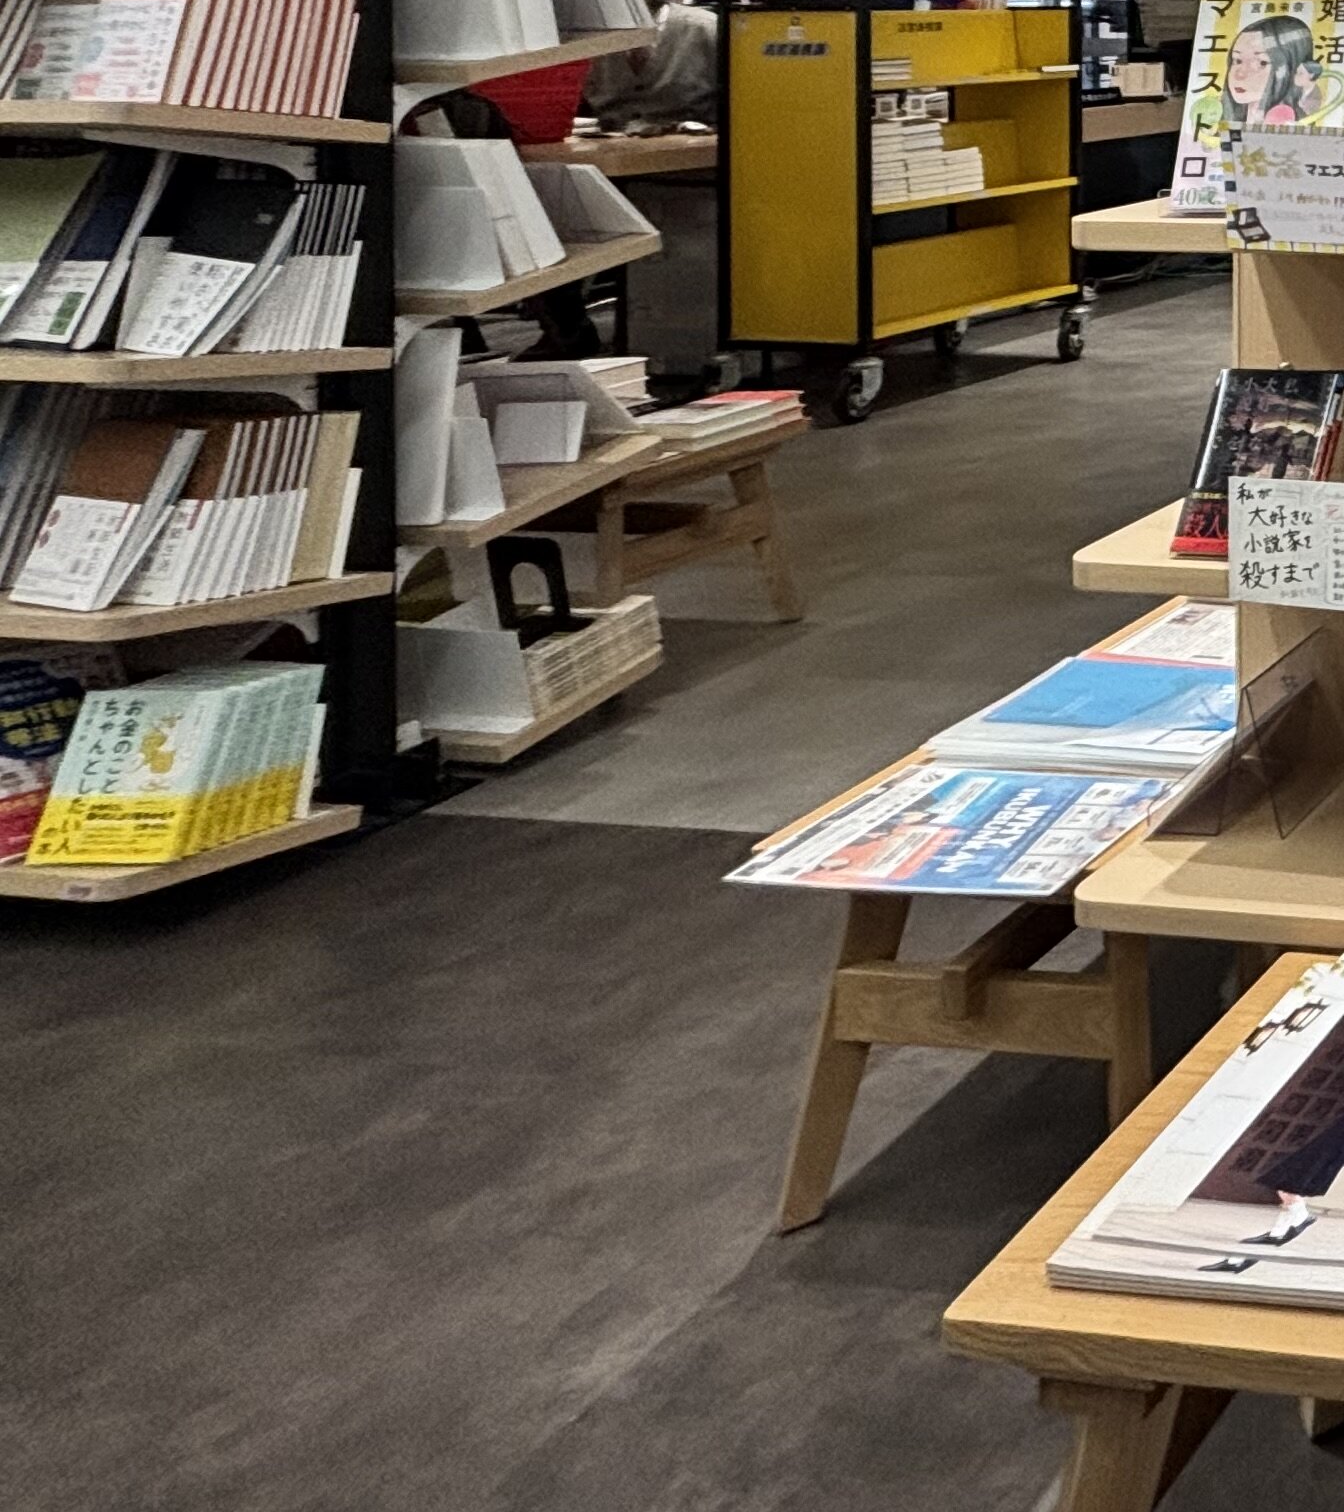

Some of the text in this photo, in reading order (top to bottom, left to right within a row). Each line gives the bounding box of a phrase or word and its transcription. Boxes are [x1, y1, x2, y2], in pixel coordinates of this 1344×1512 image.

[1235, 483, 1274, 504] 私が
[1248, 505, 1314, 527] 大好きな
[1243, 531, 1314, 554] 小説家を
[1239, 559, 1320, 591] 殺すまで
